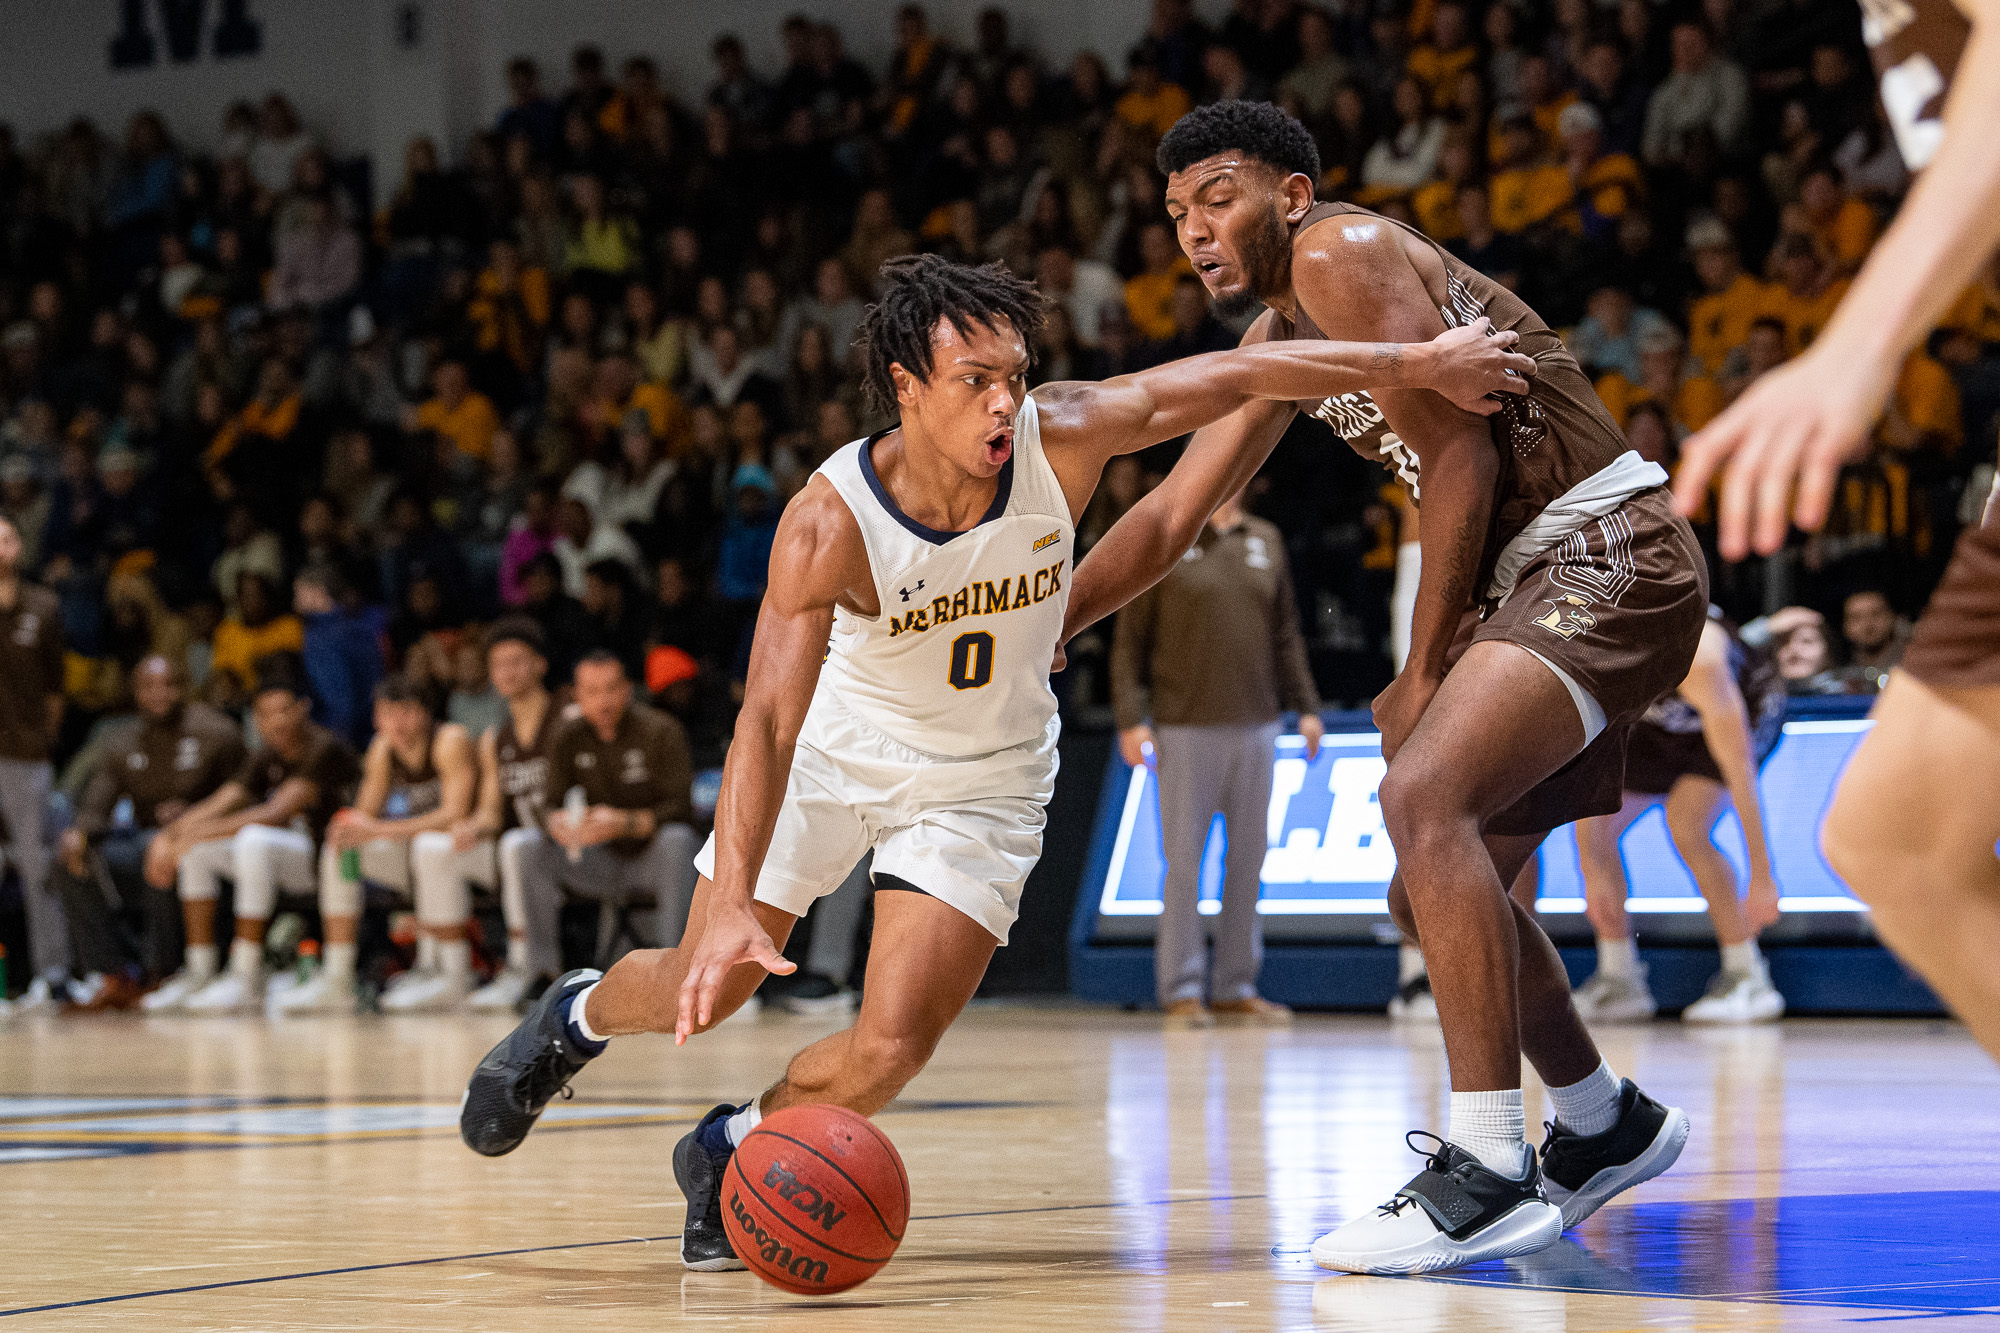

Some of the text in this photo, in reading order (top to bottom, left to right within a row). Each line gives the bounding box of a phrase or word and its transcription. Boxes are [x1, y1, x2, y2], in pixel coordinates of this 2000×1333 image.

[1032, 529, 1062, 552] NEC
[888, 559, 1066, 638] MERRIMACK
[947, 629, 997, 692] 0
[762, 1160, 847, 1232] NCAA
[729, 1189, 830, 1284] Wilson
